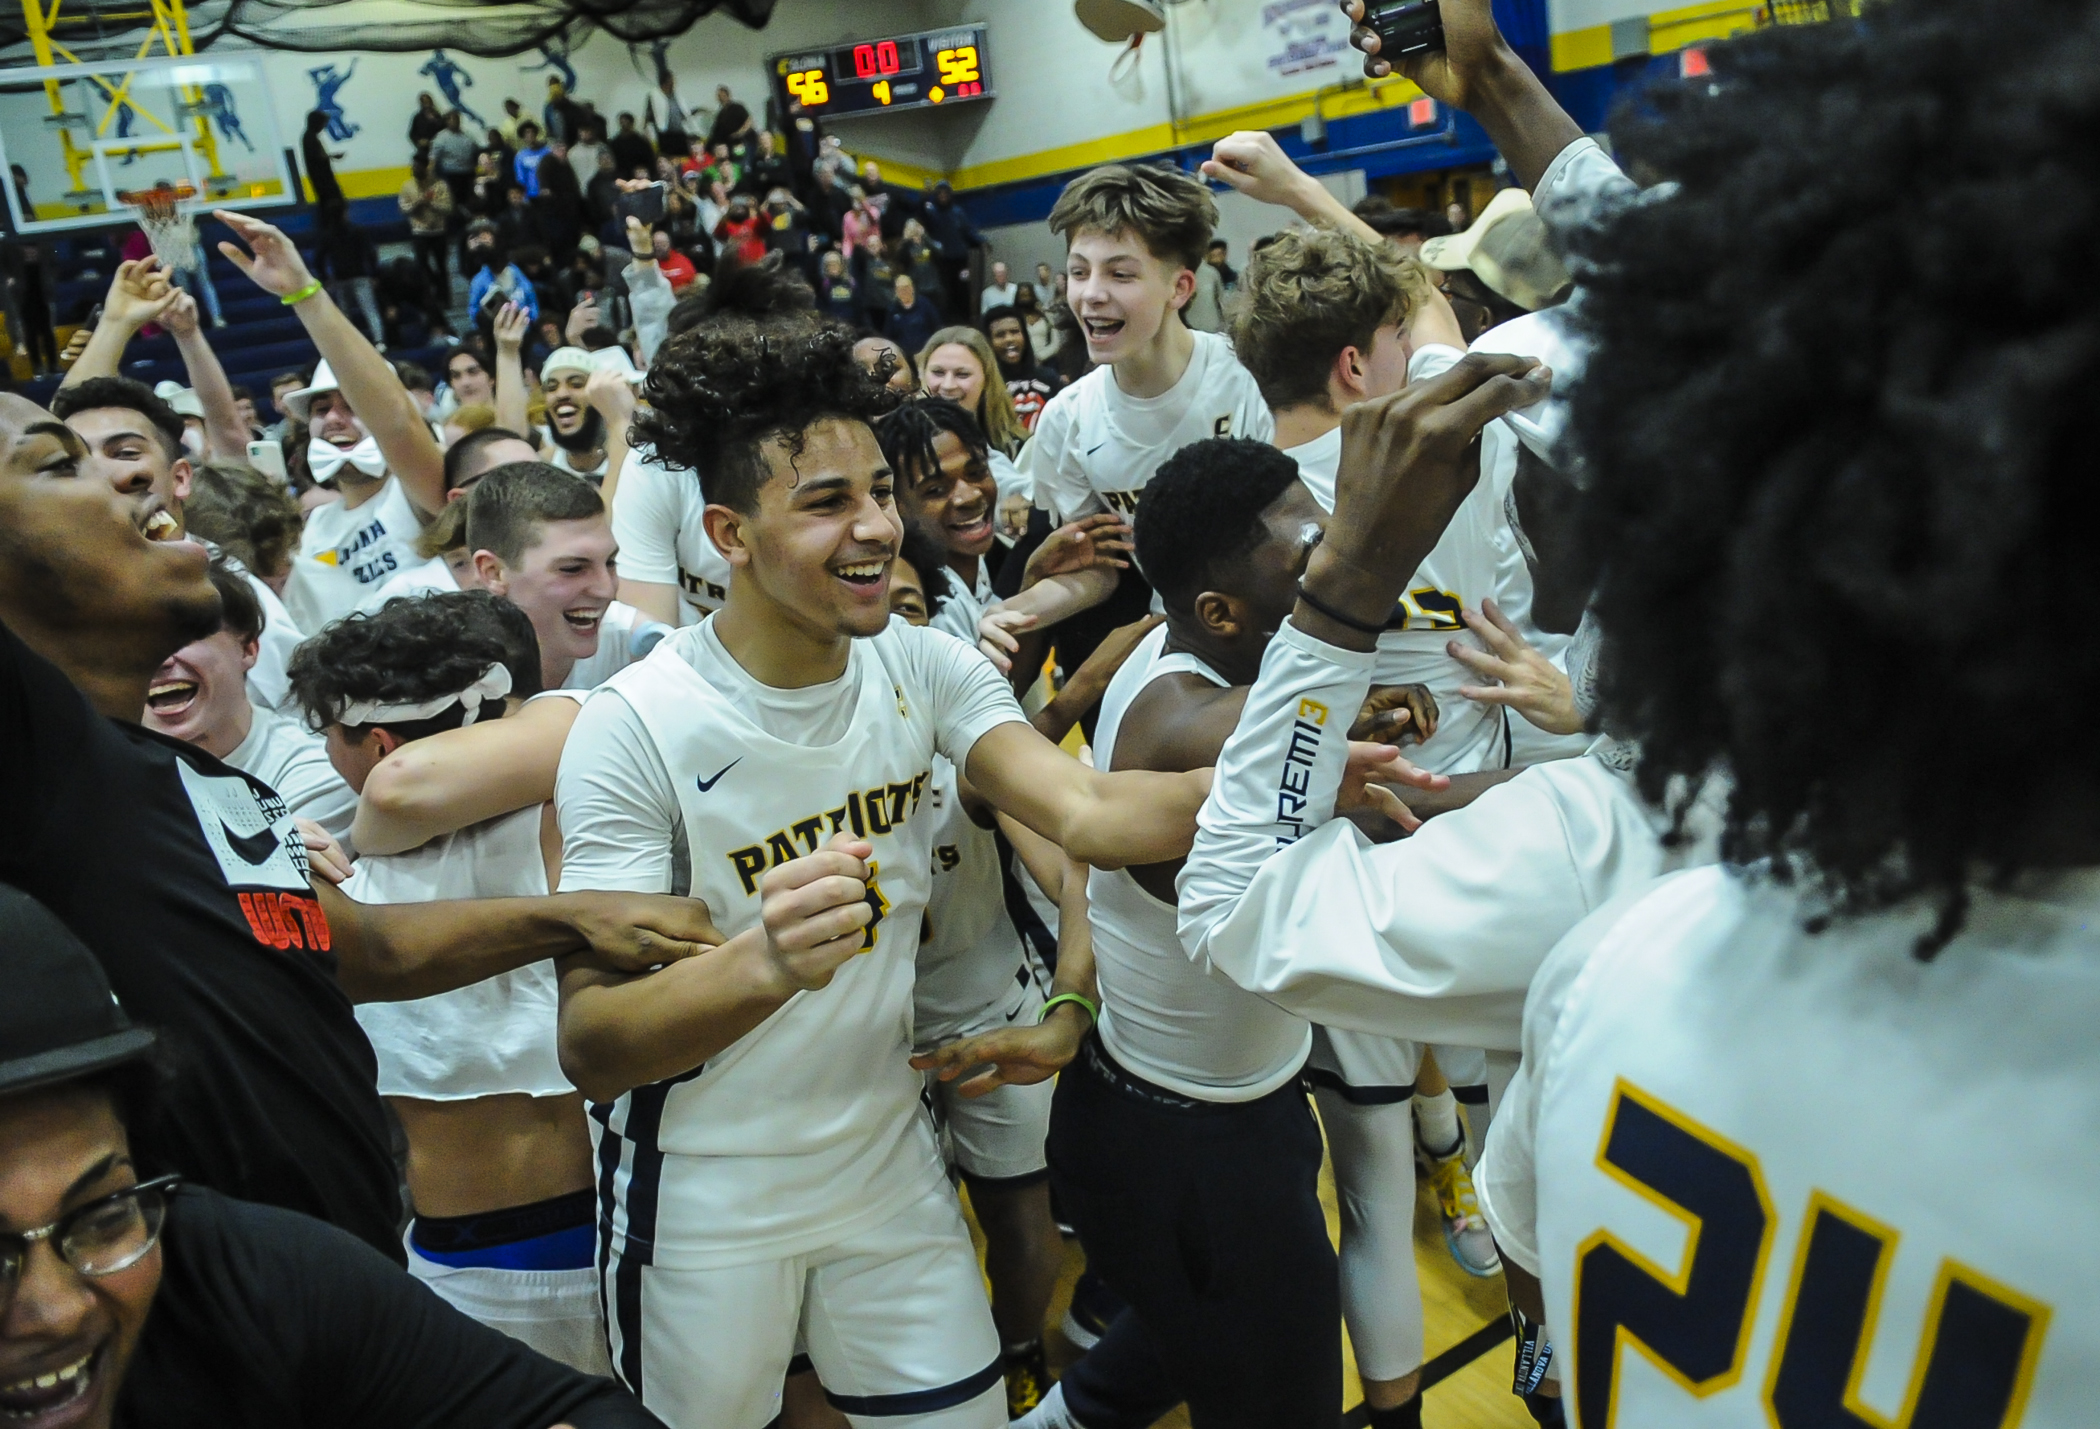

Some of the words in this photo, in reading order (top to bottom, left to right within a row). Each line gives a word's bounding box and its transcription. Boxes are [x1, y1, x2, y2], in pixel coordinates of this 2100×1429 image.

[937, 46, 979, 85] 52
[786, 70, 829, 106] 56
[1571, 1074, 2054, 1429] 24
